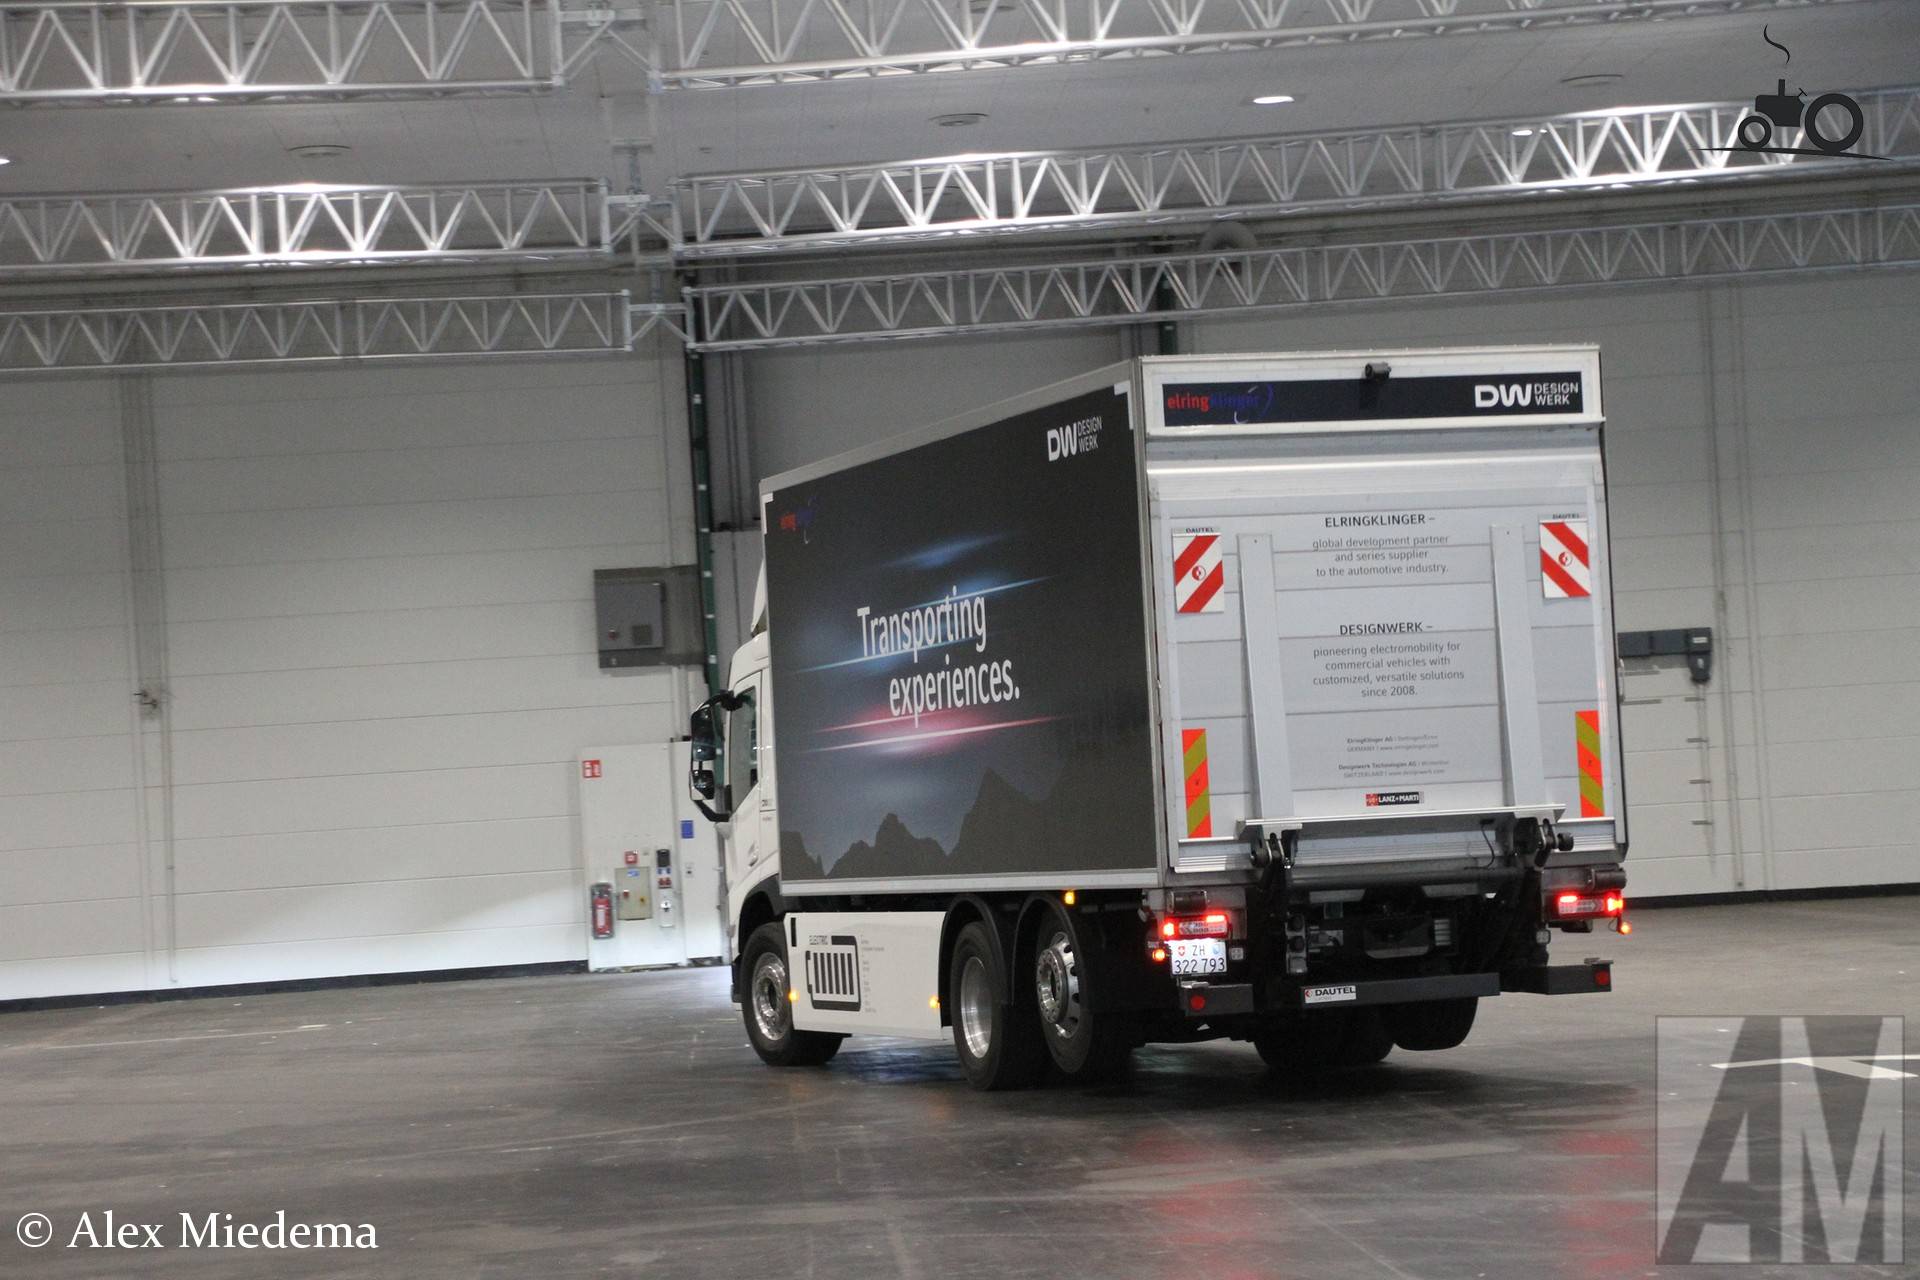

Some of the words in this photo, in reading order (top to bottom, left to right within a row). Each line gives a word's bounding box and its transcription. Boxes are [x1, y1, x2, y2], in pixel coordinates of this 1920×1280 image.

[1474, 383, 1532, 408] DW
[1534, 382, 1578, 394] DESIGN
[1535, 394, 1570, 406] WERK
[1077, 416, 1102, 436] DESIGN
[1047, 422, 1077, 461] DW
[1079, 434, 1098, 453] WERK
[1325, 513, 1426, 528] ELRINGKLINGER
[1312, 538, 1343, 551] global
[1346, 536, 1410, 549] development
[1413, 535, 1449, 546] partner
[1334, 552, 1353, 562] and
[1356, 550, 1386, 561] series
[1388, 549, 1428, 562] supplier
[1316, 567, 1326, 577] to
[1329, 566, 1345, 576] the
[1347, 564, 1403, 575] automotive
[1406, 562, 1449, 576] industry.
[857, 585, 987, 663] Transporting
[1339, 622, 1423, 636] DESIGNWERK
[1313, 646, 1367, 659] pioneering
[1370, 642, 1444, 655] electromobility
[1447, 641, 1461, 652] for
[1325, 659, 1384, 671] commercial
[1387, 657, 1427, 668] vehicles
[1429, 656, 1451, 667] with
[1312, 673, 1373, 686] customized,
[1376, 671, 1417, 682] versatile
[1420, 670, 1465, 681] solutions
[889, 653, 1020, 728] experiences.
[1361, 687, 1388, 697] since
[1390, 686, 1418, 697] 2008.
[1192, 945, 1206, 956] ZH
[1174, 959, 1198, 974] 322
[1201, 957, 1225, 972] 793
[1315, 986, 1356, 996] DAUTEL
